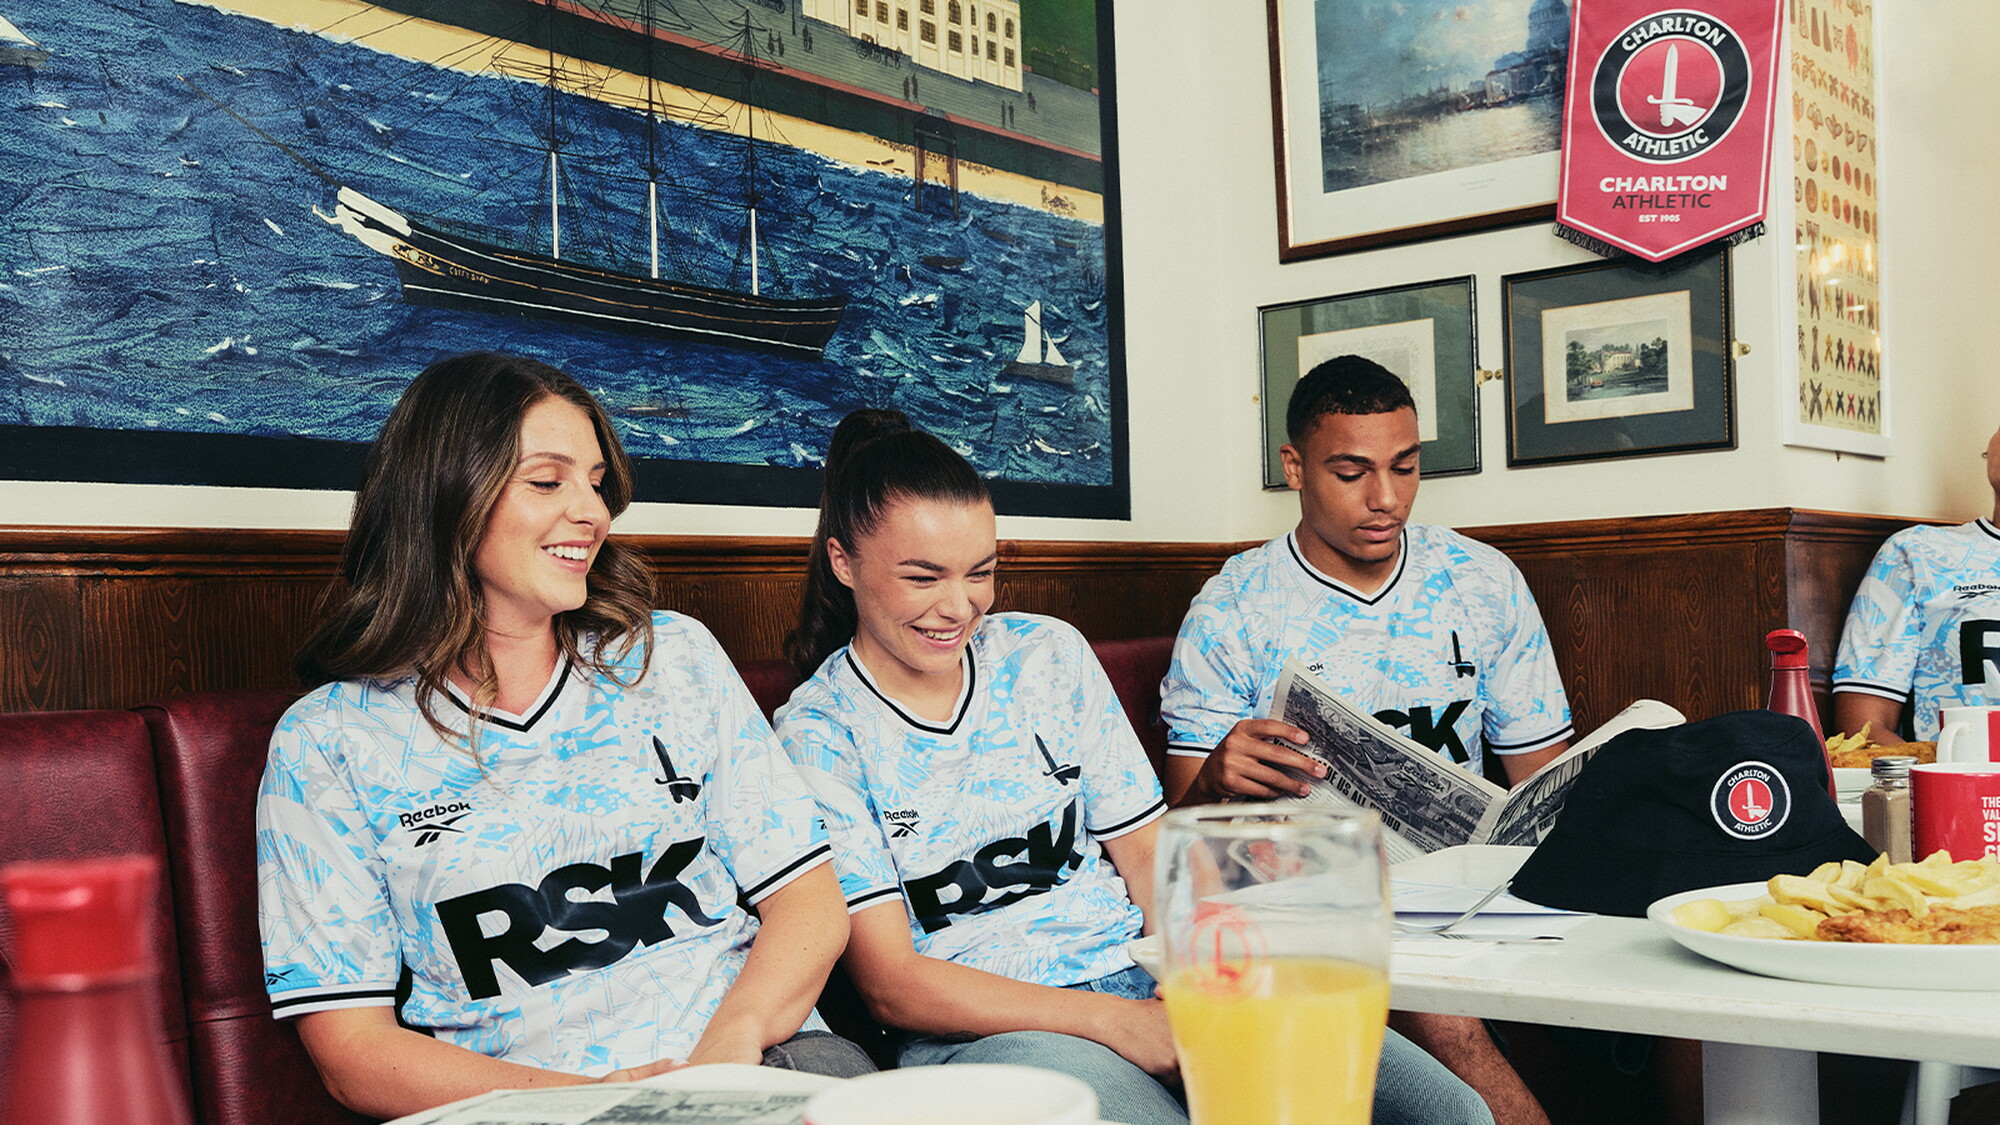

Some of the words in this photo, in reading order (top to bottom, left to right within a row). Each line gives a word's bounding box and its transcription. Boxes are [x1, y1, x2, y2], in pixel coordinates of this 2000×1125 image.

[1622, 17, 1726, 51] CHARLTON
[1622, 129, 1710, 156] ATHLETIC
[1600, 175, 1727, 192] CHARLTON
[1612, 194, 1711, 209] ATHLETIC
[1638, 214, 1658, 223] EST
[1660, 214, 1681, 223] 1905
[1728, 769, 1771, 787] CHARLTON
[1337, 775, 1352, 796] US
[1369, 803, 1401, 832] POUD
[1981, 796, 2000, 808] THE
[399, 802, 471, 827] Reebok
[1982, 809, 2000, 820] VAL
[1734, 818, 1773, 833] ATHLETIC
[903, 797, 1085, 935] RSK
[434, 836, 726, 1001] RSK
